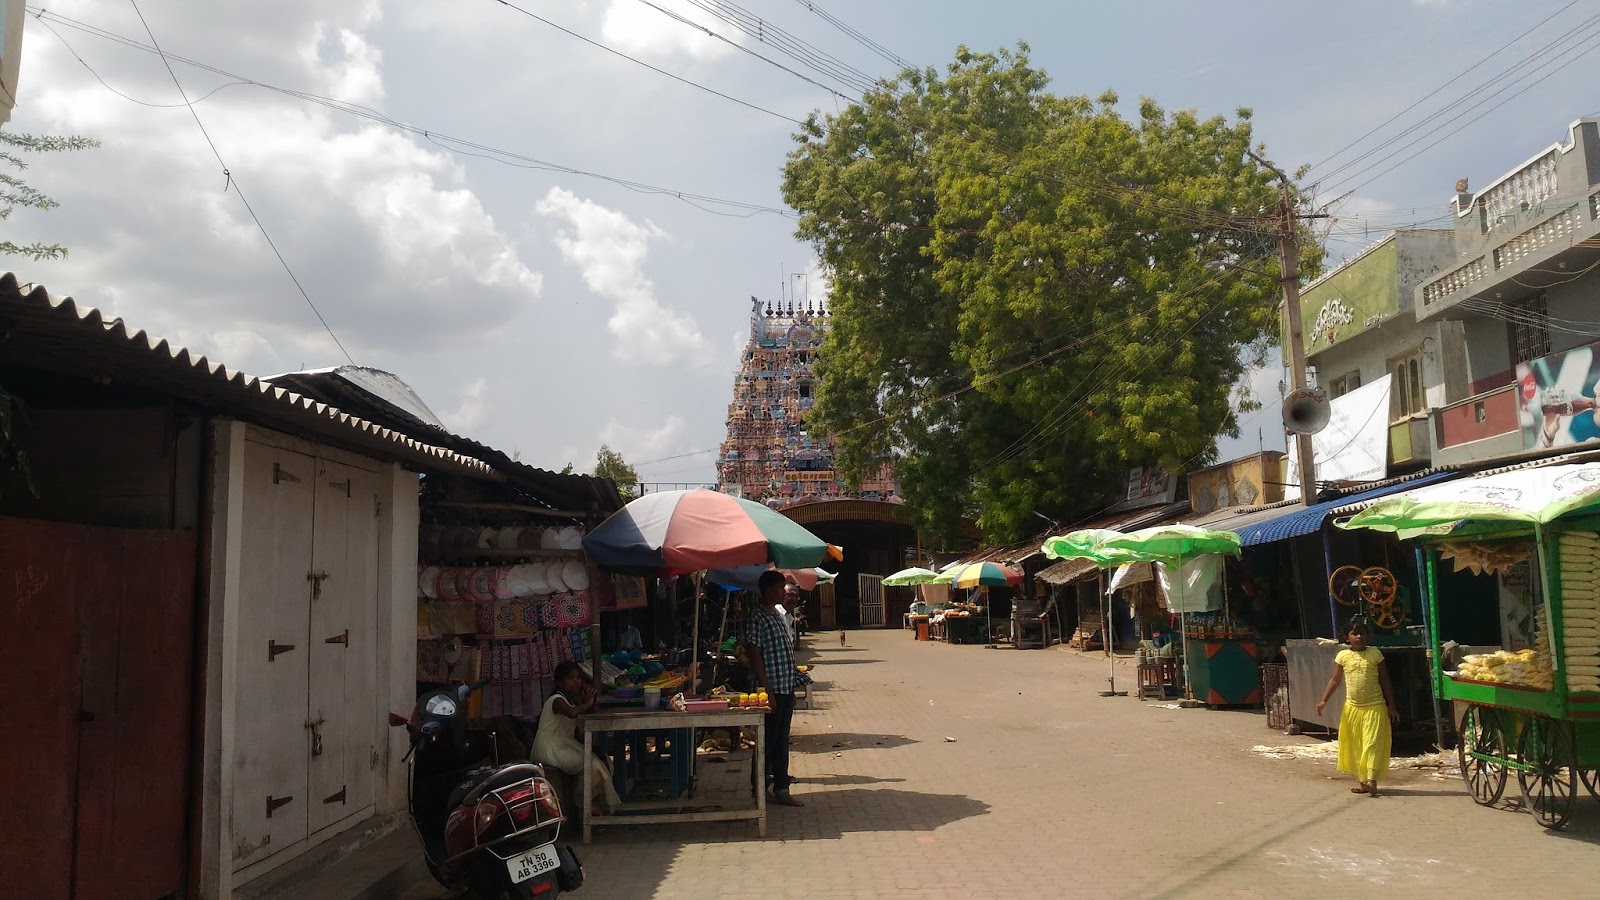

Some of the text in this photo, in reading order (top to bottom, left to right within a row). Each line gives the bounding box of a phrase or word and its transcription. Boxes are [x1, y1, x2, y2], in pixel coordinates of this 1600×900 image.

[518, 858, 555, 880] AB 3396
[520, 852, 547, 868] TN 50
